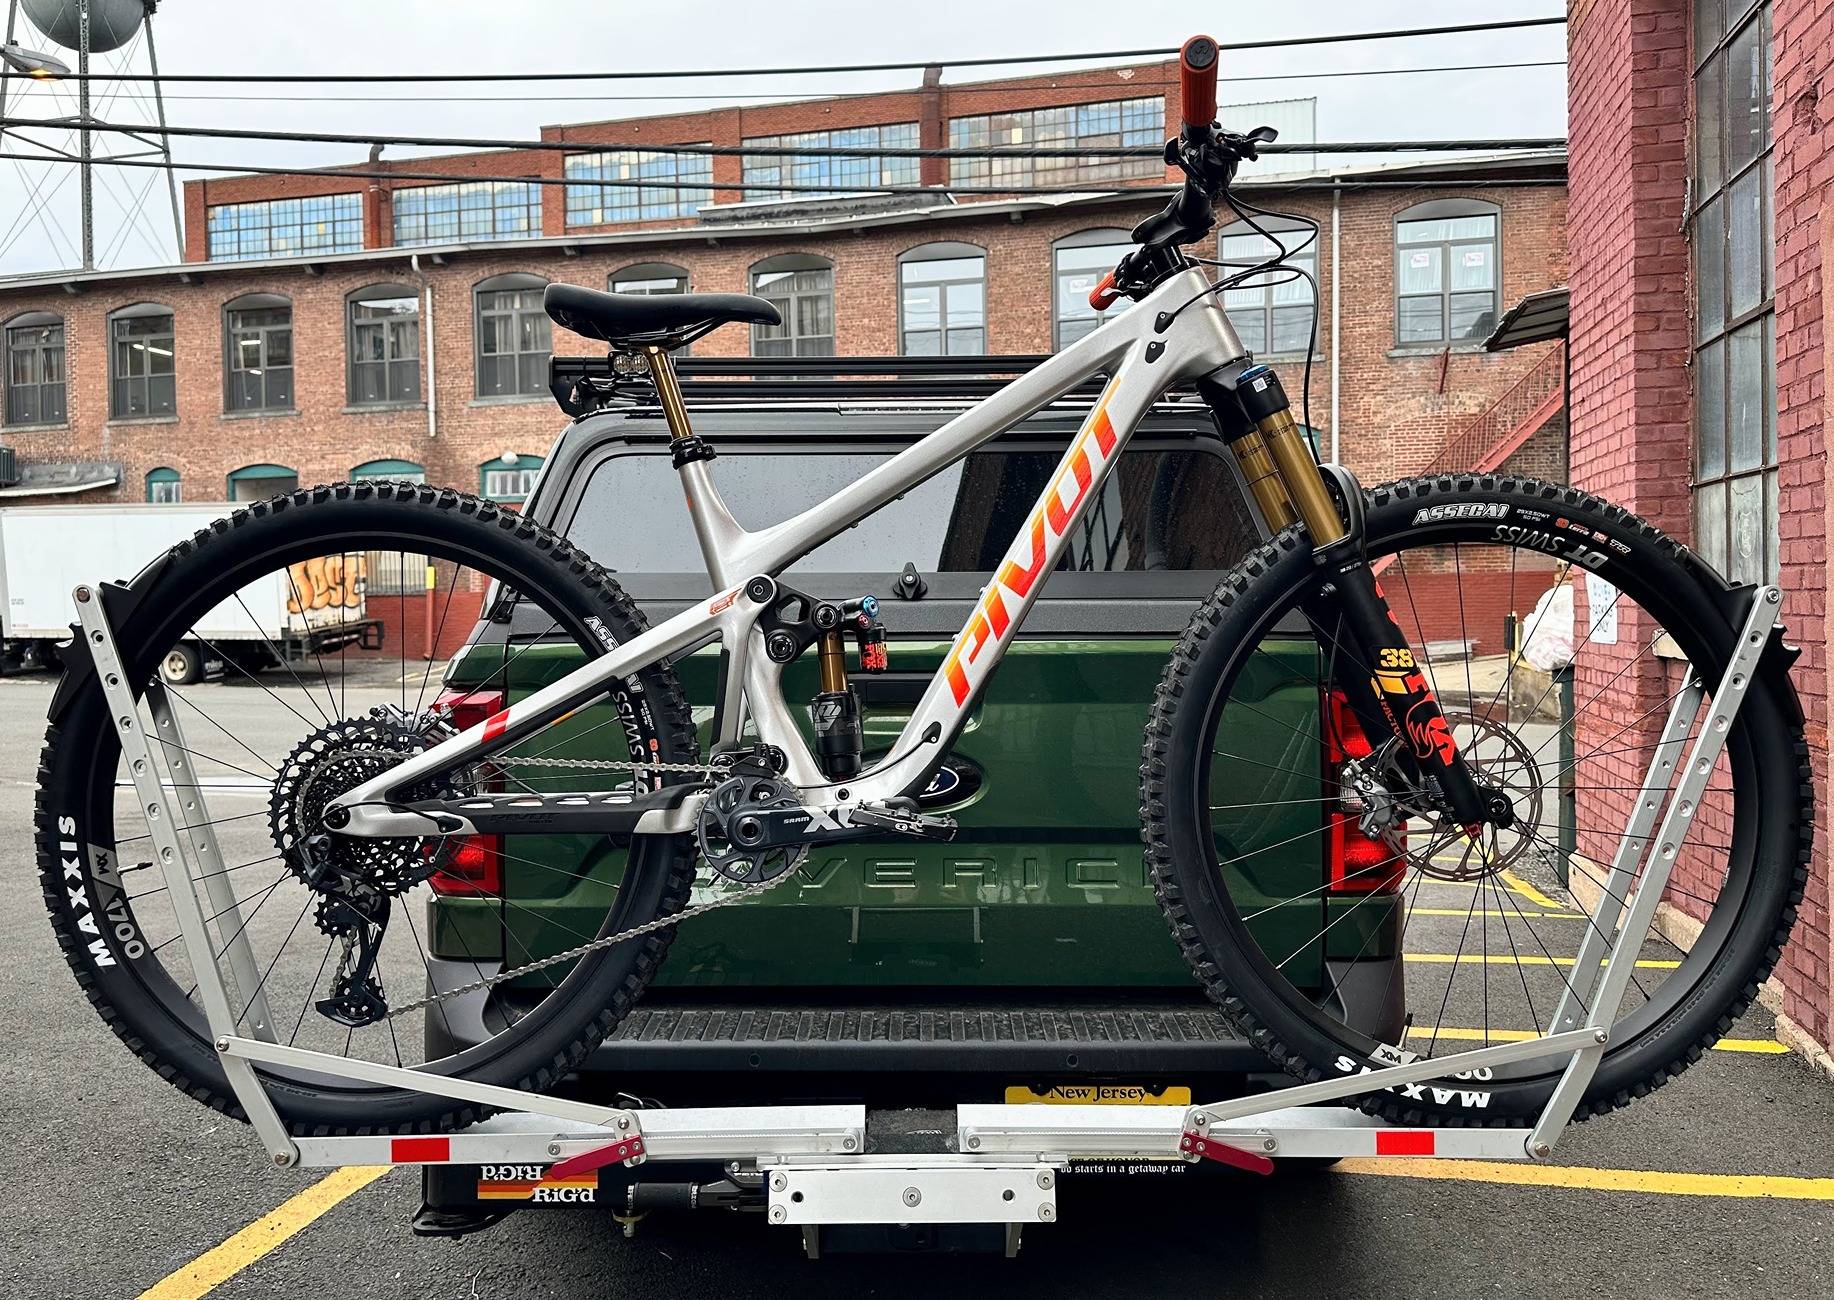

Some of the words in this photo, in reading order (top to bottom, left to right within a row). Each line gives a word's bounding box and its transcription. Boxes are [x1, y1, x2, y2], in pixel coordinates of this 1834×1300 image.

[1411, 502, 1510, 525] ASSEGAI
[944, 376, 1121, 709] PIVOT
[1491, 525, 1565, 552] SWISS
[1563, 544, 1609, 569] DT
[583, 615, 644, 694] ASSAI
[1380, 647, 1415, 668] 38
[612, 690, 645, 756] SWISS
[783, 815, 810, 825] SRAM
[800, 856, 1155, 889] VERIC
[58, 815, 117, 967] MAXXIS
[95, 851, 111, 875] XM
[105, 897, 145, 960] 1700
[1381, 1048, 1402, 1064] XM
[1048, 1086, 1091, 1099] New
[1093, 1086, 1148, 1102] Jersey
[1334, 1055, 1491, 1109] MAXS
[1075, 1164, 1104, 1174] starts
[1106, 1164, 1118, 1174] in
[1119, 1165, 1126, 1174] a
[1128, 1164, 1169, 1175] getaway
[1171, 1164, 1187, 1174] car
